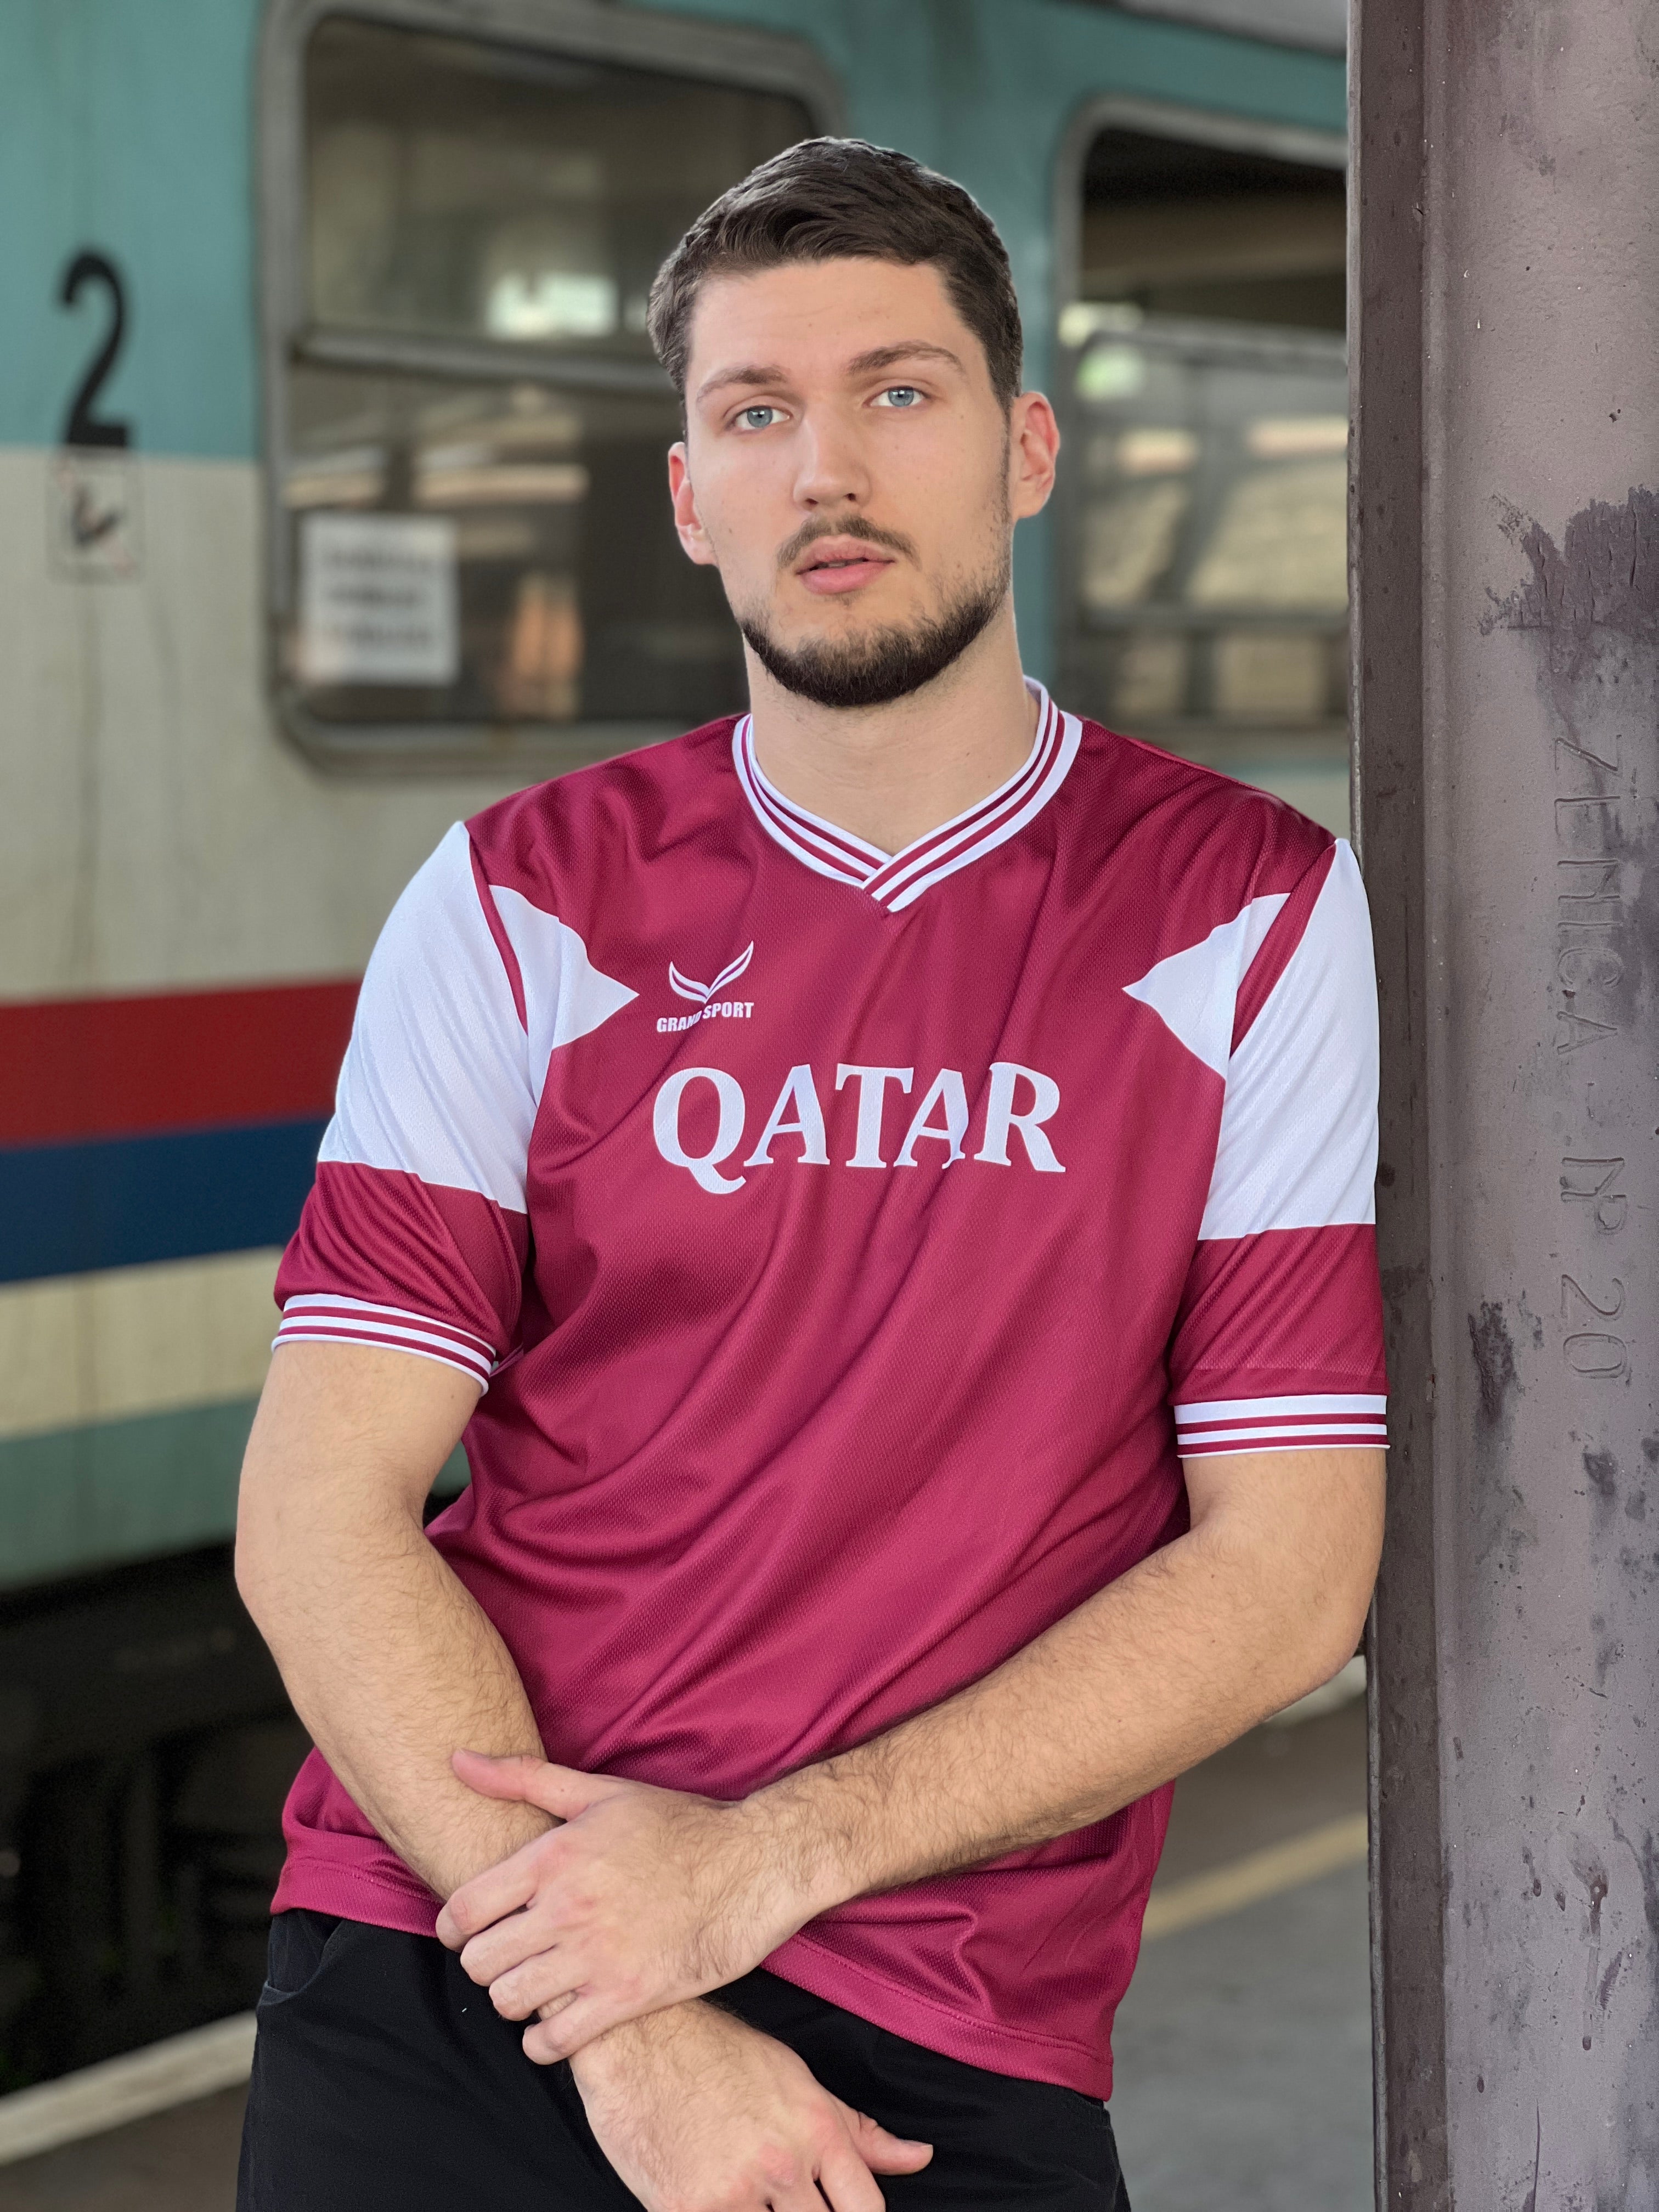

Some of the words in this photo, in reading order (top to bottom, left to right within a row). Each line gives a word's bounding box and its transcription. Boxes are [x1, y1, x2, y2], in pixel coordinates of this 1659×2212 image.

[58, 250, 129, 451] 2
[1554, 735, 1622, 1054] ZENICA
[657, 1010, 702, 1032] GRAND
[702, 1002, 754, 1019] SPORT
[653, 1062, 1066, 1194] QATAR
[1560, 1273, 1628, 1379] 20
